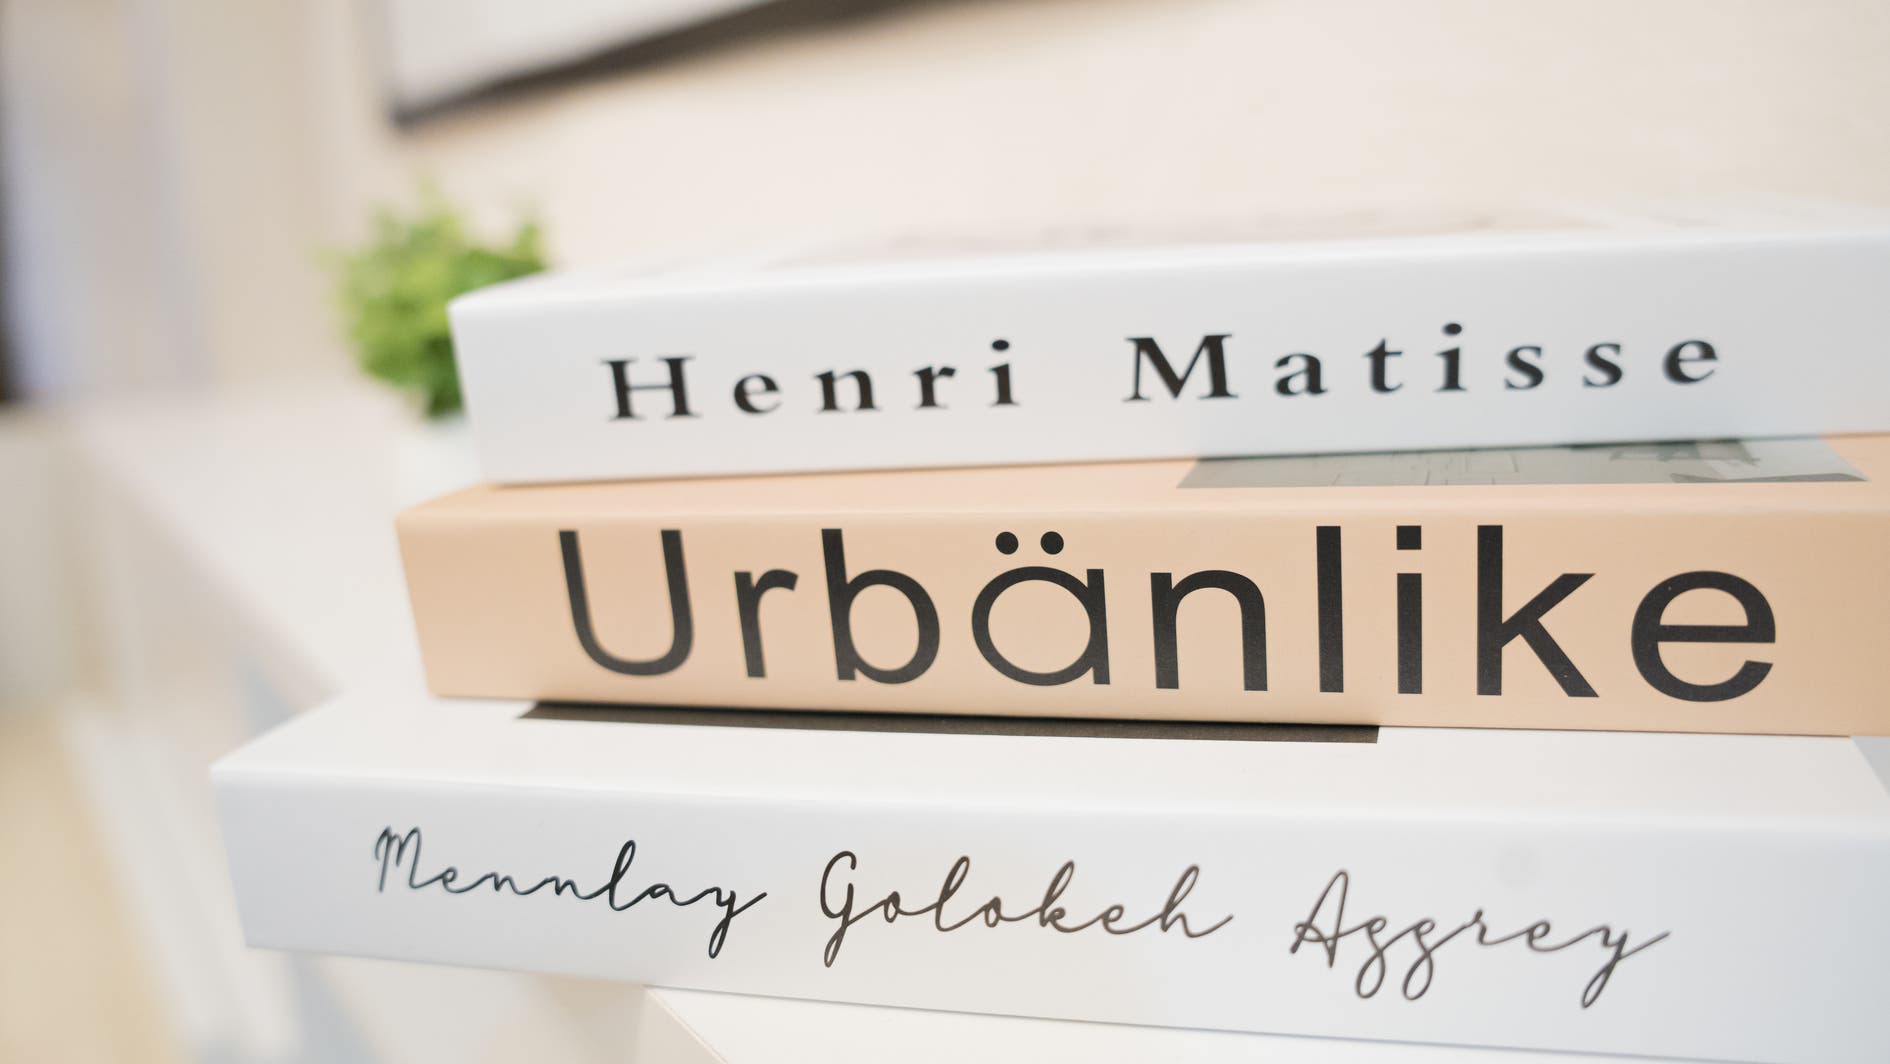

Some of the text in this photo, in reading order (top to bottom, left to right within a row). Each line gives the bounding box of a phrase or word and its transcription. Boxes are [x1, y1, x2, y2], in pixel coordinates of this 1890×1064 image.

[601, 322, 1720, 421] Henri Matisse
[558, 524, 1777, 702] Urbänlike
[373, 826, 1671, 1009] Mennlay Golokeh Aggrey
